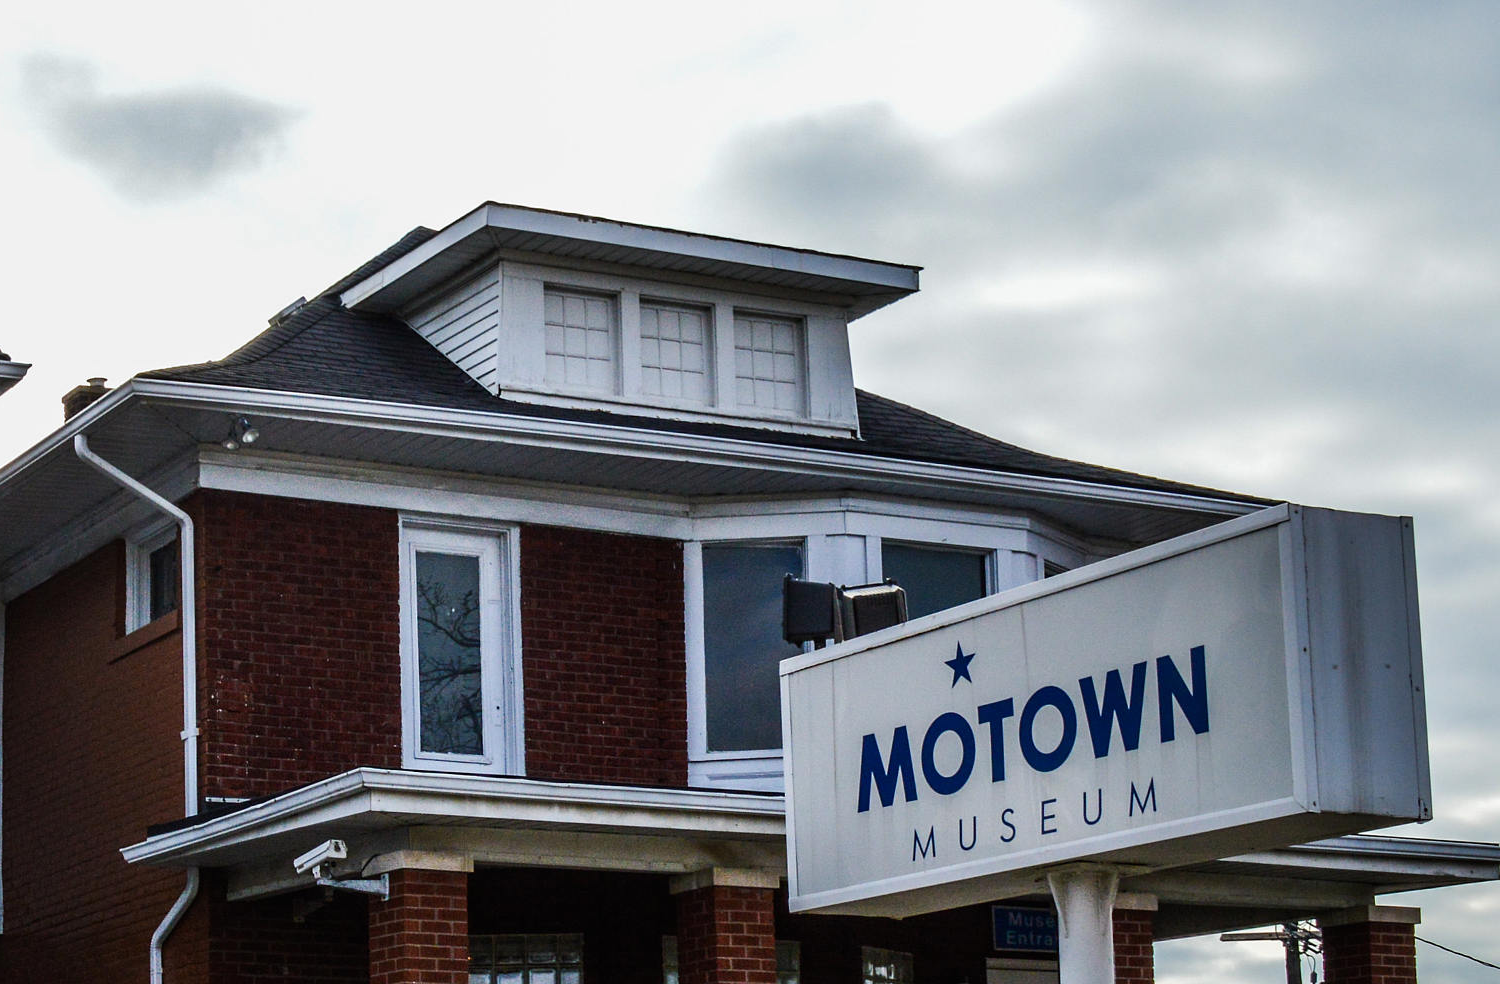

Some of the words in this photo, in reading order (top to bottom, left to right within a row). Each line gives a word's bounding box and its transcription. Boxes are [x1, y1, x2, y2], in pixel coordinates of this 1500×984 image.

[856, 644, 1210, 814] MOTOWN
[911, 776, 1158, 863] MUSEUM
[1006, 930, 1053, 946] Entra
[1008, 911, 1055, 928] Muse
